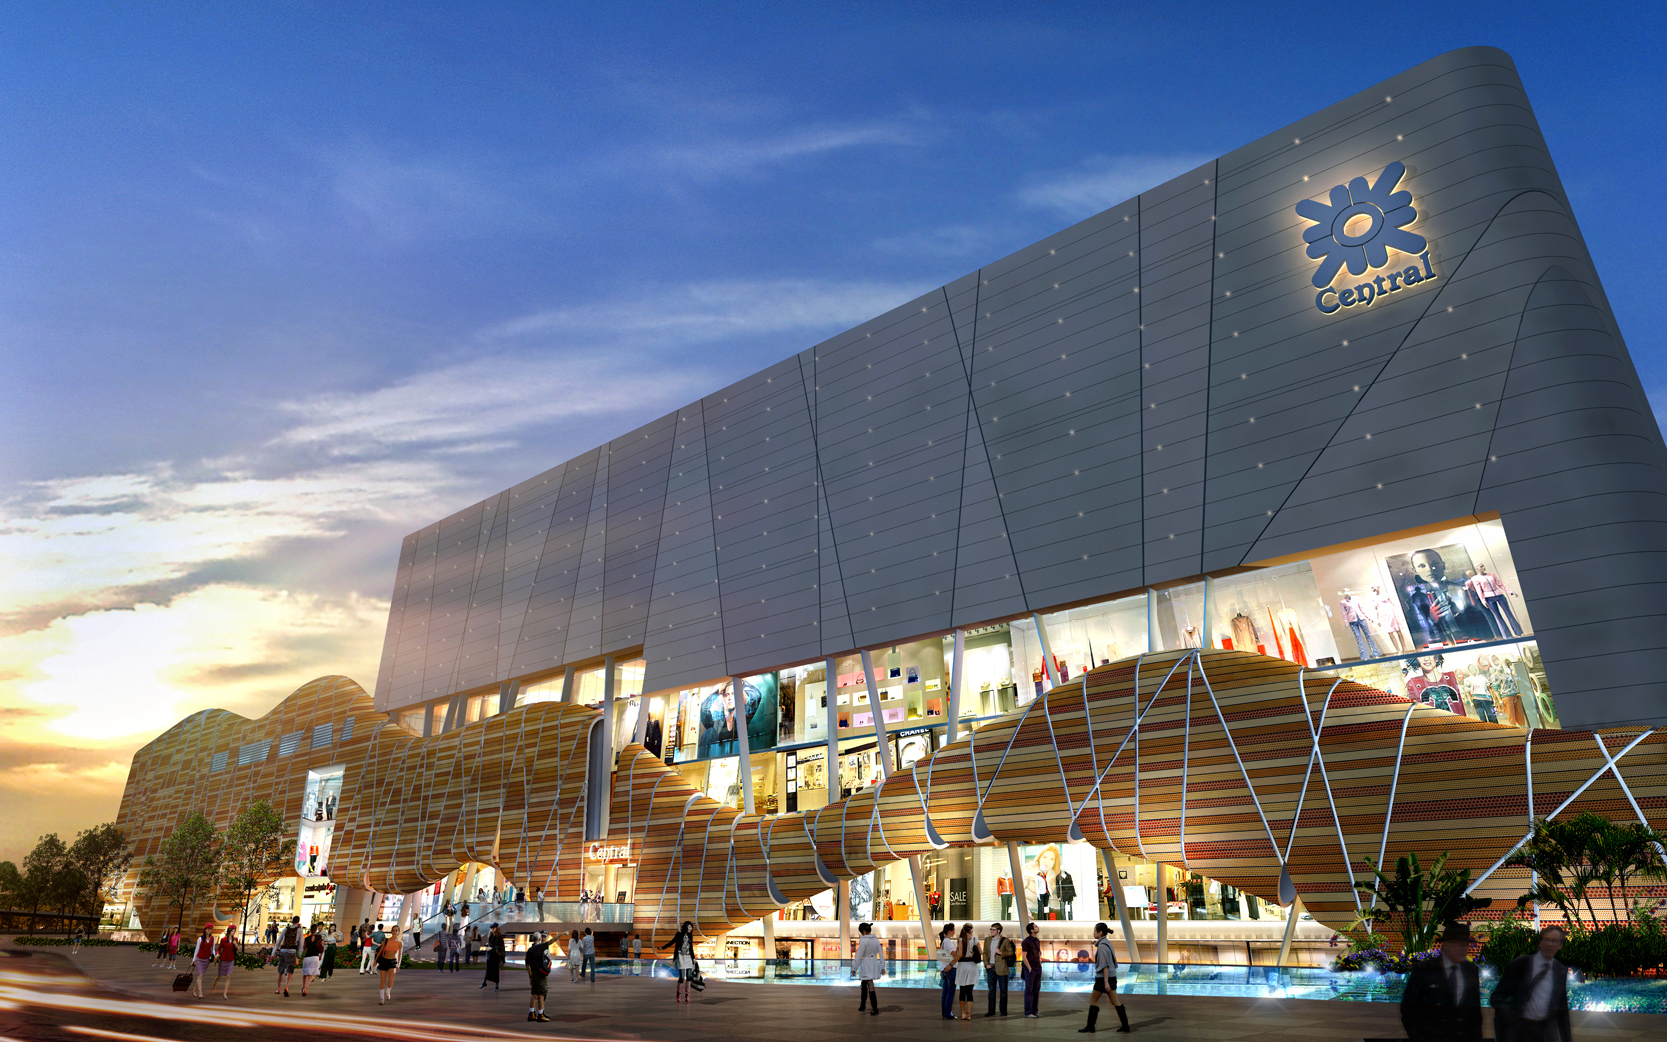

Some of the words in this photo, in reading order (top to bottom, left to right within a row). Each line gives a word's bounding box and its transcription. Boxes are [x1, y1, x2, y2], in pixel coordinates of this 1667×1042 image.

[1315, 250, 1437, 315] Central
[899, 728, 930, 737] CHANEL
[589, 839, 633, 863] Central
[949, 891, 967, 902] SALE
